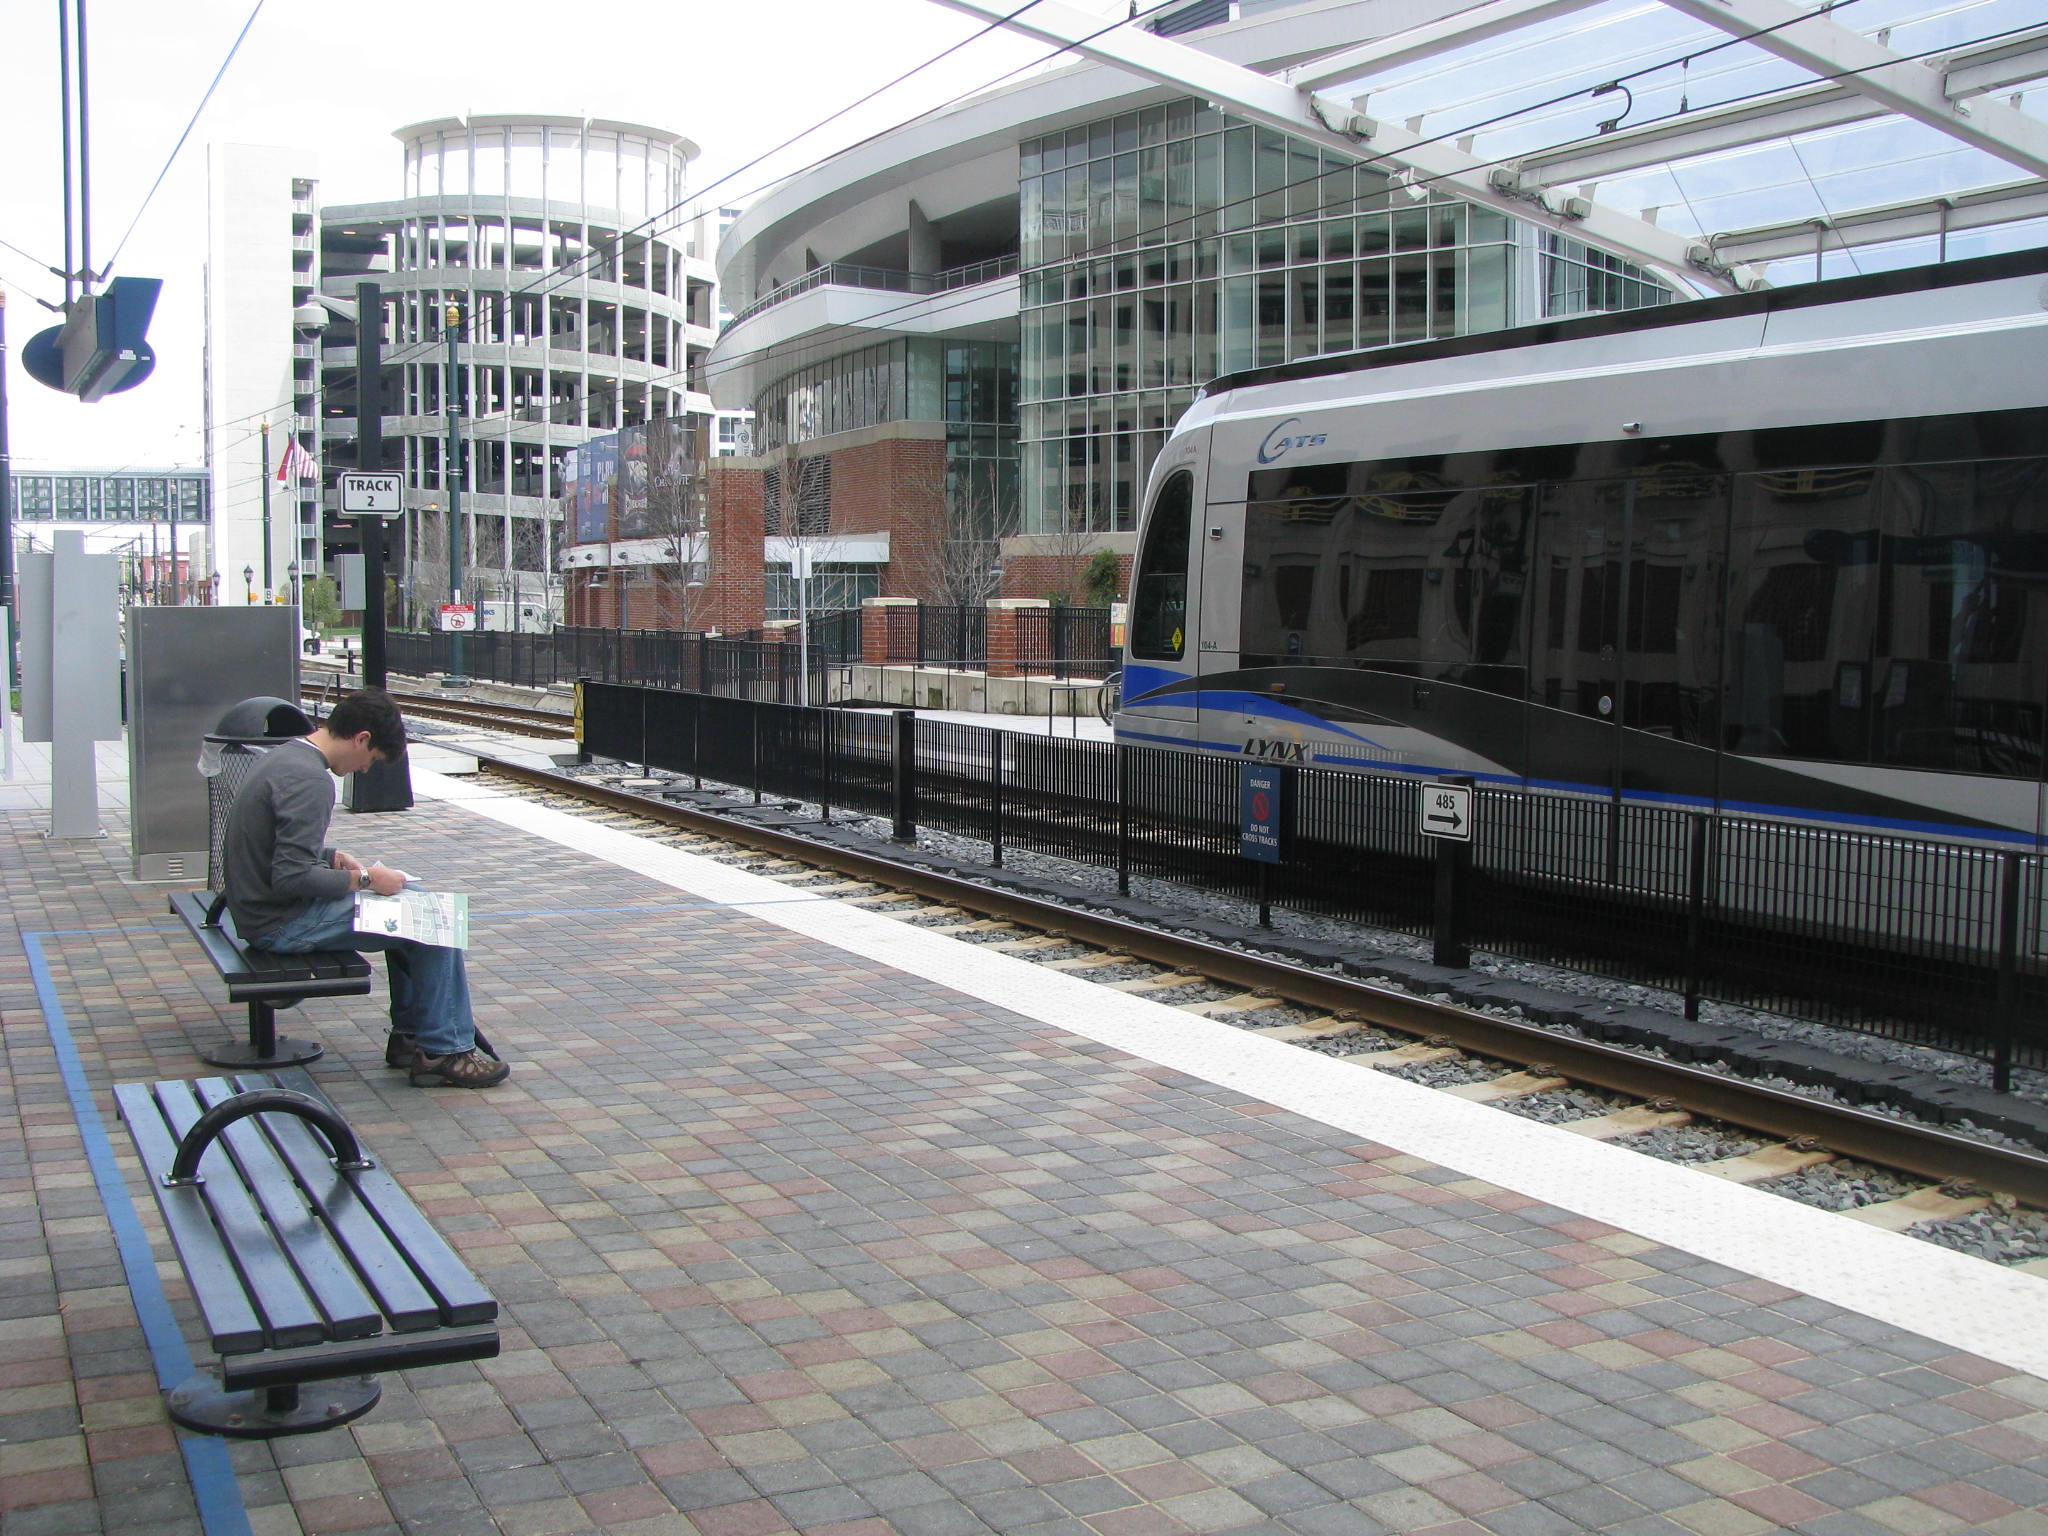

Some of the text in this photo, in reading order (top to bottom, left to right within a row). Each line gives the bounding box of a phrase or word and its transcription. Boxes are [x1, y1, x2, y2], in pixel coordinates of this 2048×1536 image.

[1258, 418, 1328, 464] CATS
[348, 479, 393, 492] TRACK
[367, 495, 375, 507] 2
[1201, 641, 1218, 650] 104-A
[1243, 738, 1309, 762] LYNX
[1250, 779, 1272, 790] DANGER
[1435, 793, 1455, 810] 485
[1250, 823, 1270, 835] DO NOT
[1242, 832, 1278, 847] CROSS TRACKS
